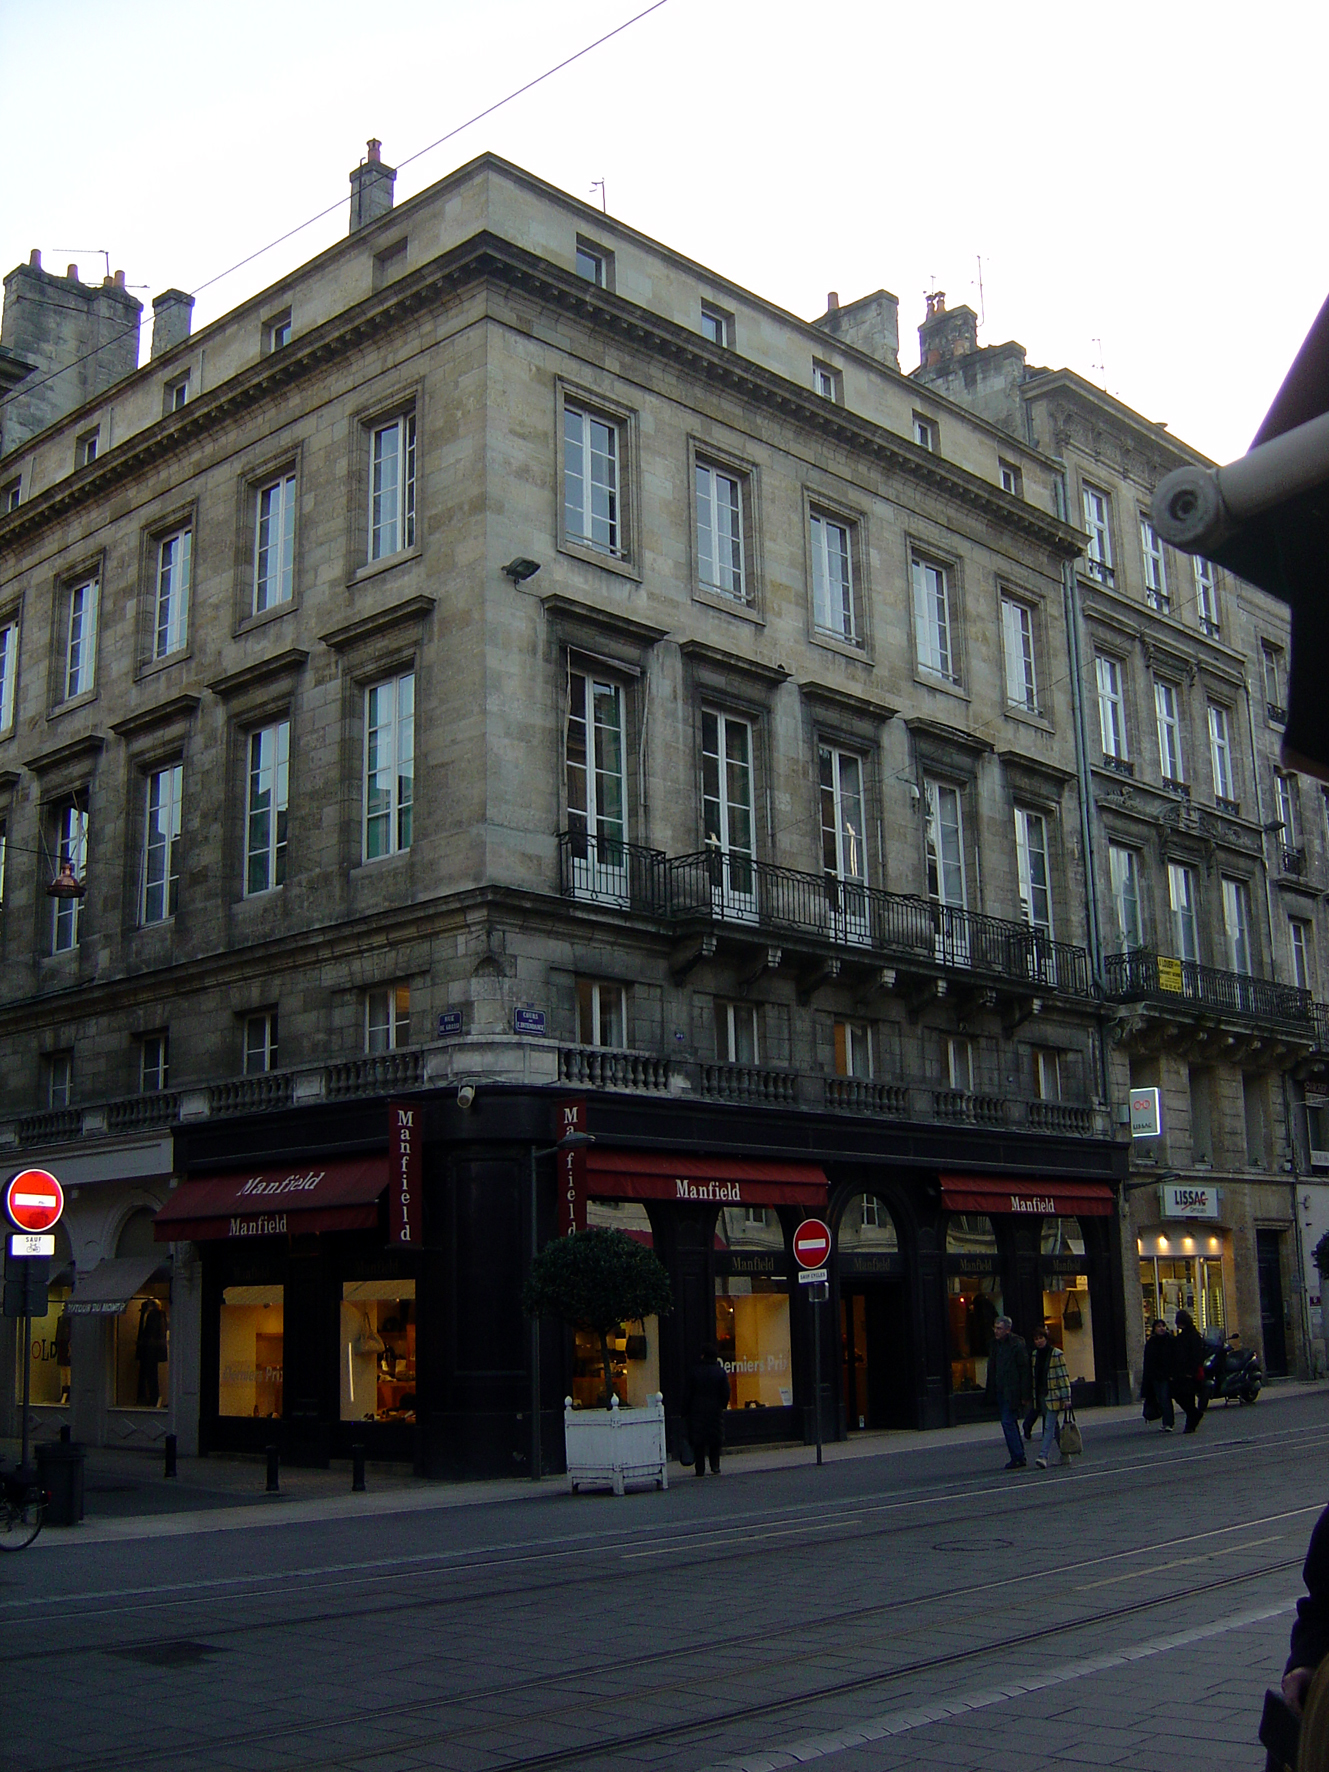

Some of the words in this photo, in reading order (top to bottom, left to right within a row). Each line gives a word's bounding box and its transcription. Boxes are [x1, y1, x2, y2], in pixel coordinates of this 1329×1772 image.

[397, 1109, 414, 1241] Manfield
[563, 1106, 578, 1236] Mafield
[236, 1171, 326, 1197] Manfield
[675, 1179, 741, 1201] Manfield
[1009, 1195, 1056, 1213] Manfield
[1174, 1190, 1206, 1206] LISSAC
[229, 1213, 288, 1236] Manfield
[732, 1256, 774, 1271] Manfield
[853, 1257, 891, 1272] Manfield
[959, 1258, 993, 1271] Manfield
[1053, 1258, 1081, 1271] Manfield
